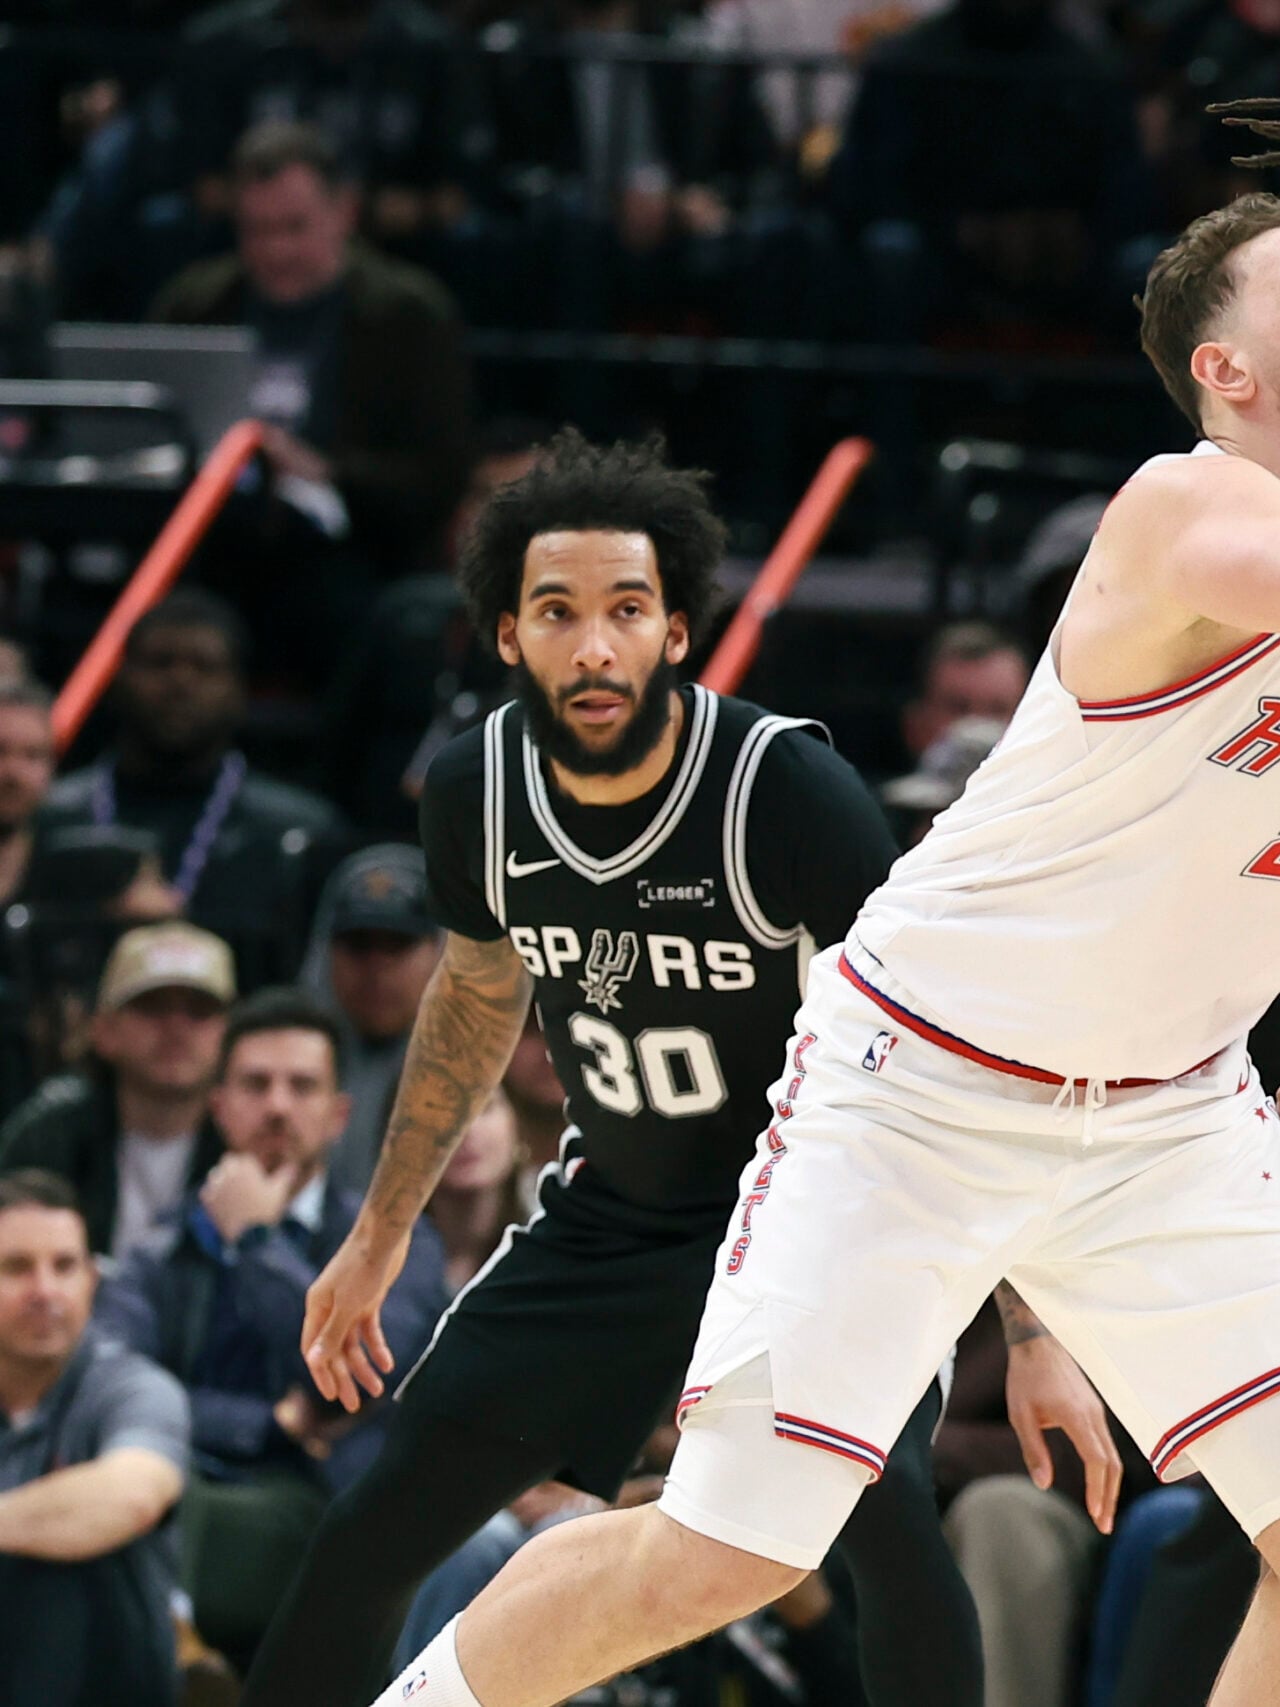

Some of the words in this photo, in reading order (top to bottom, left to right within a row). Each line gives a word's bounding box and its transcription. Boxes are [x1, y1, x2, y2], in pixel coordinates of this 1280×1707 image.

[647, 886, 705, 901] LEDGER
[509, 925, 756, 1015] SPURS
[567, 1010, 730, 1120] 30
